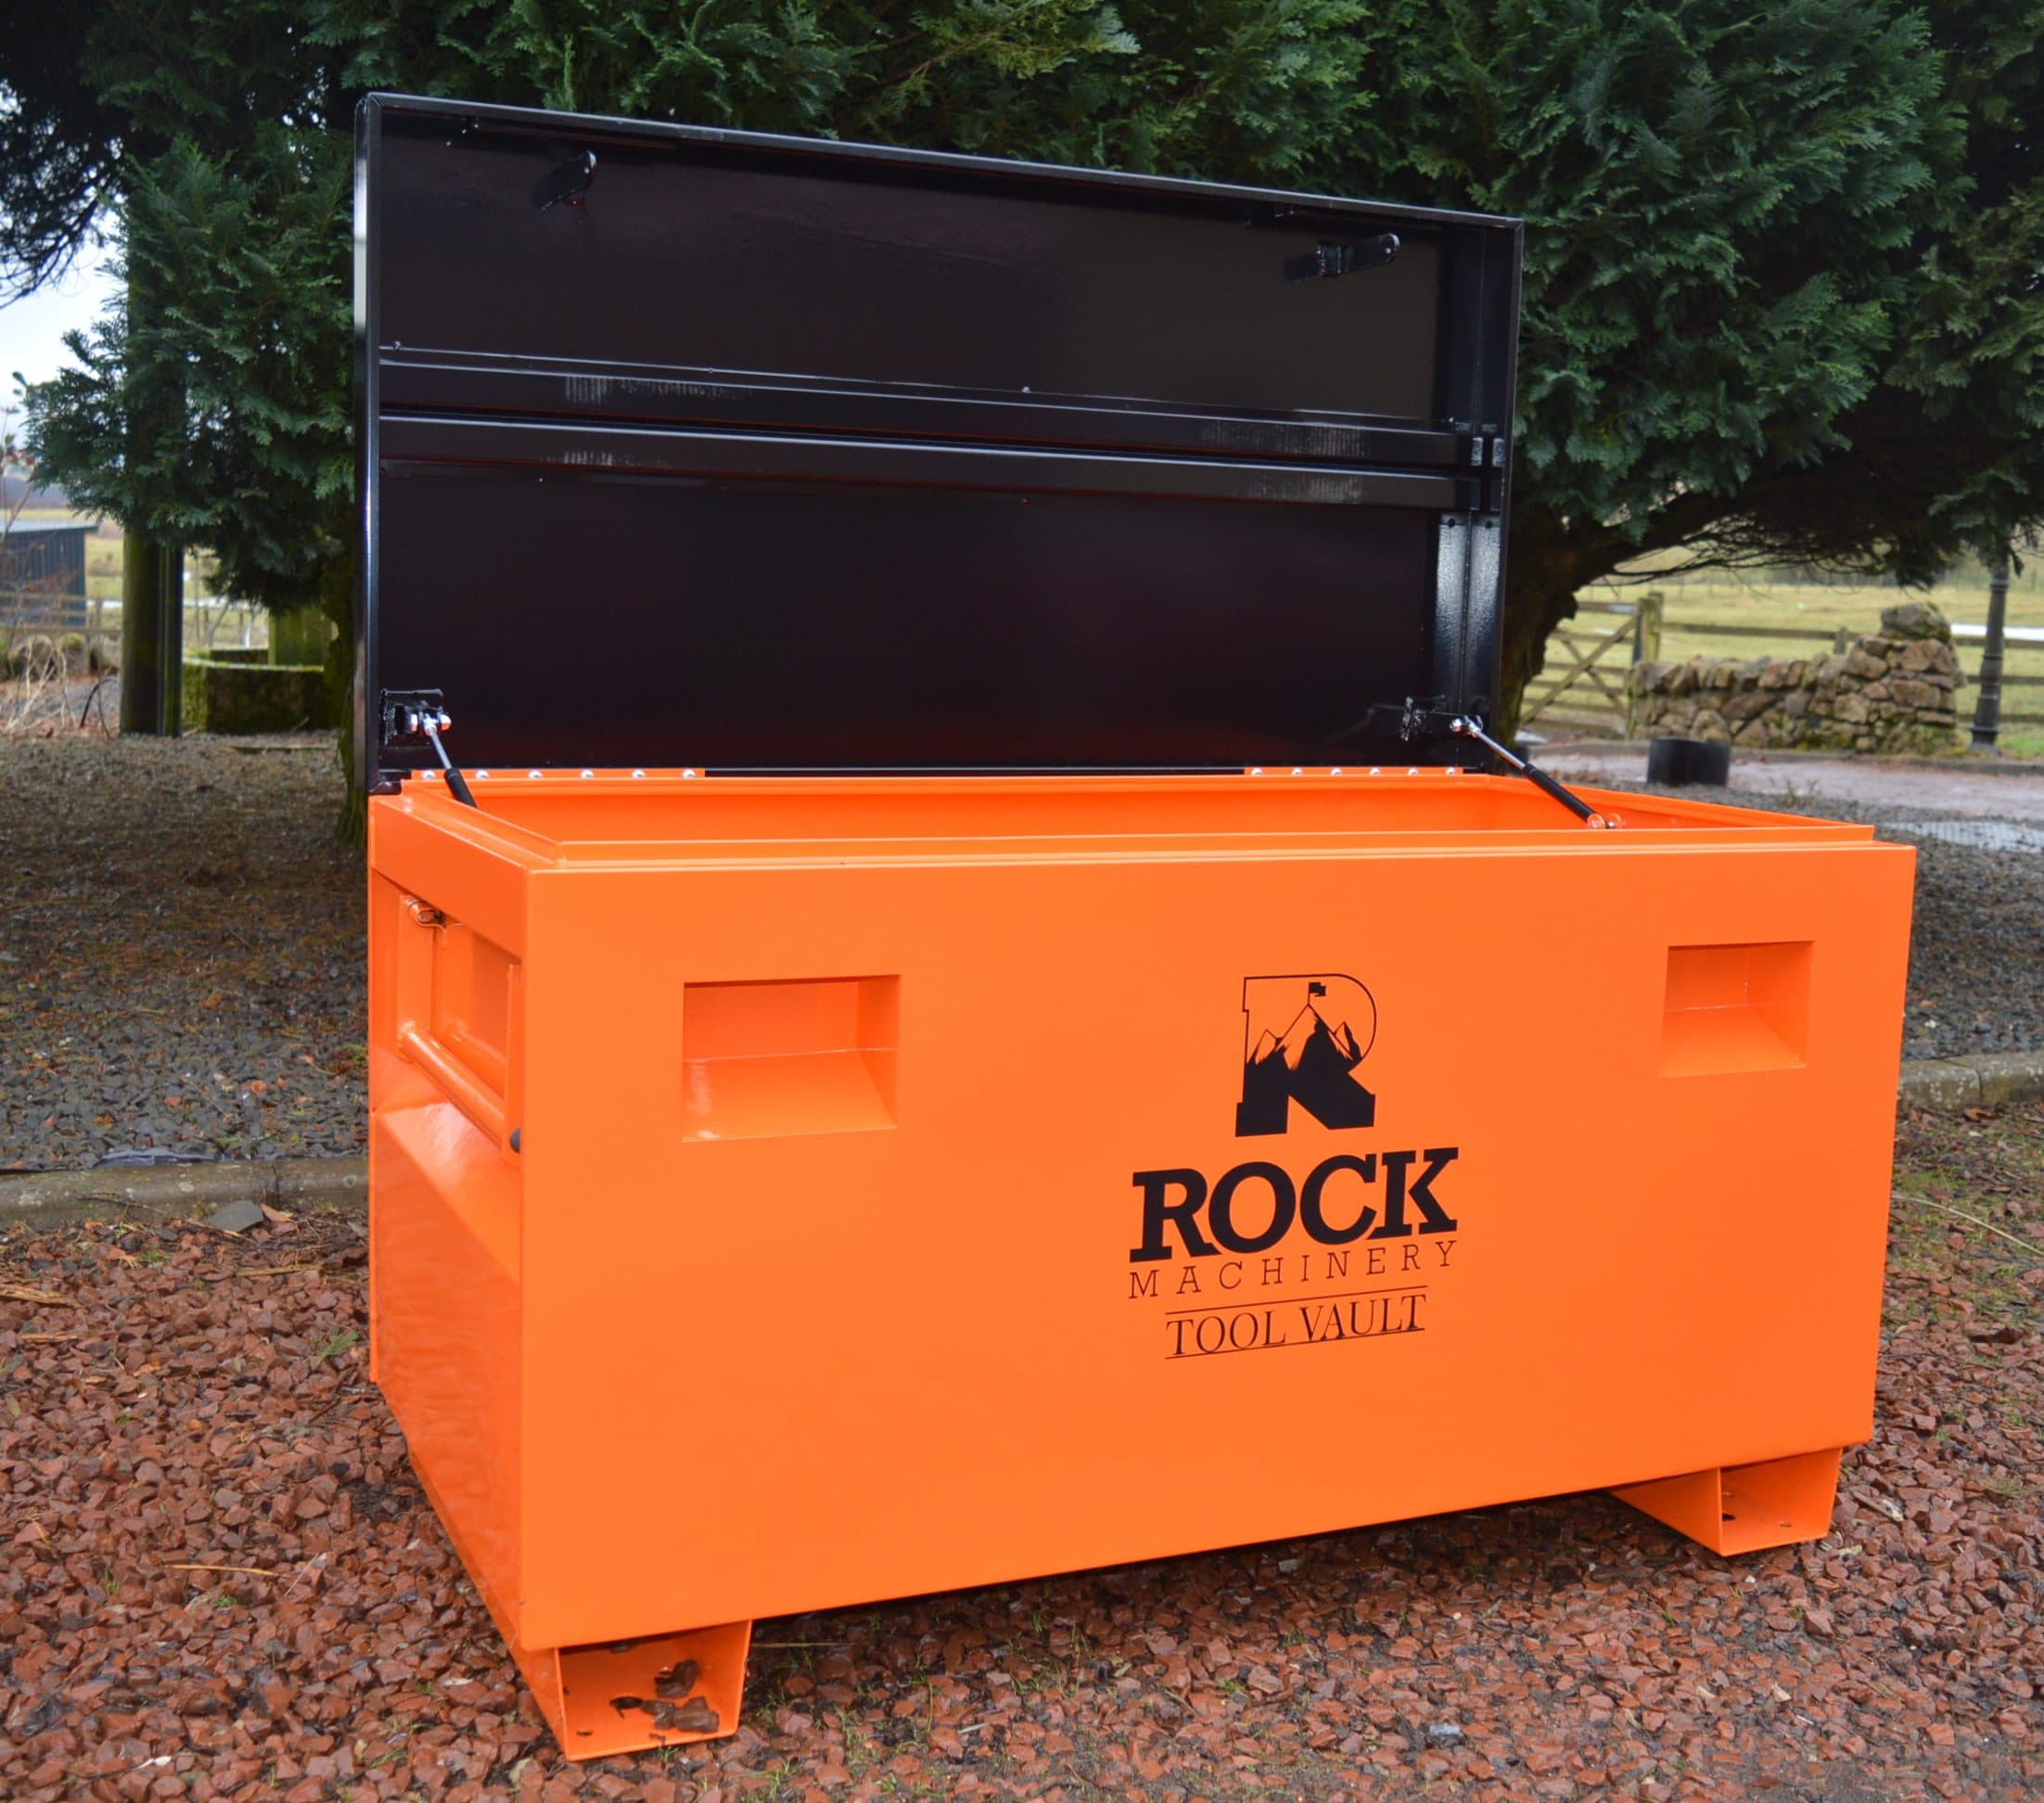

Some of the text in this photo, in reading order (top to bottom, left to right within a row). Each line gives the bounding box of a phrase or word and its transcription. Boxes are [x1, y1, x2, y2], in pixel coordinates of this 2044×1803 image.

[1130, 1146, 1459, 1263] ROCK
[1129, 1240, 1457, 1298] MACHINERY
[1166, 1294, 1426, 1355] TOOL VAULT
